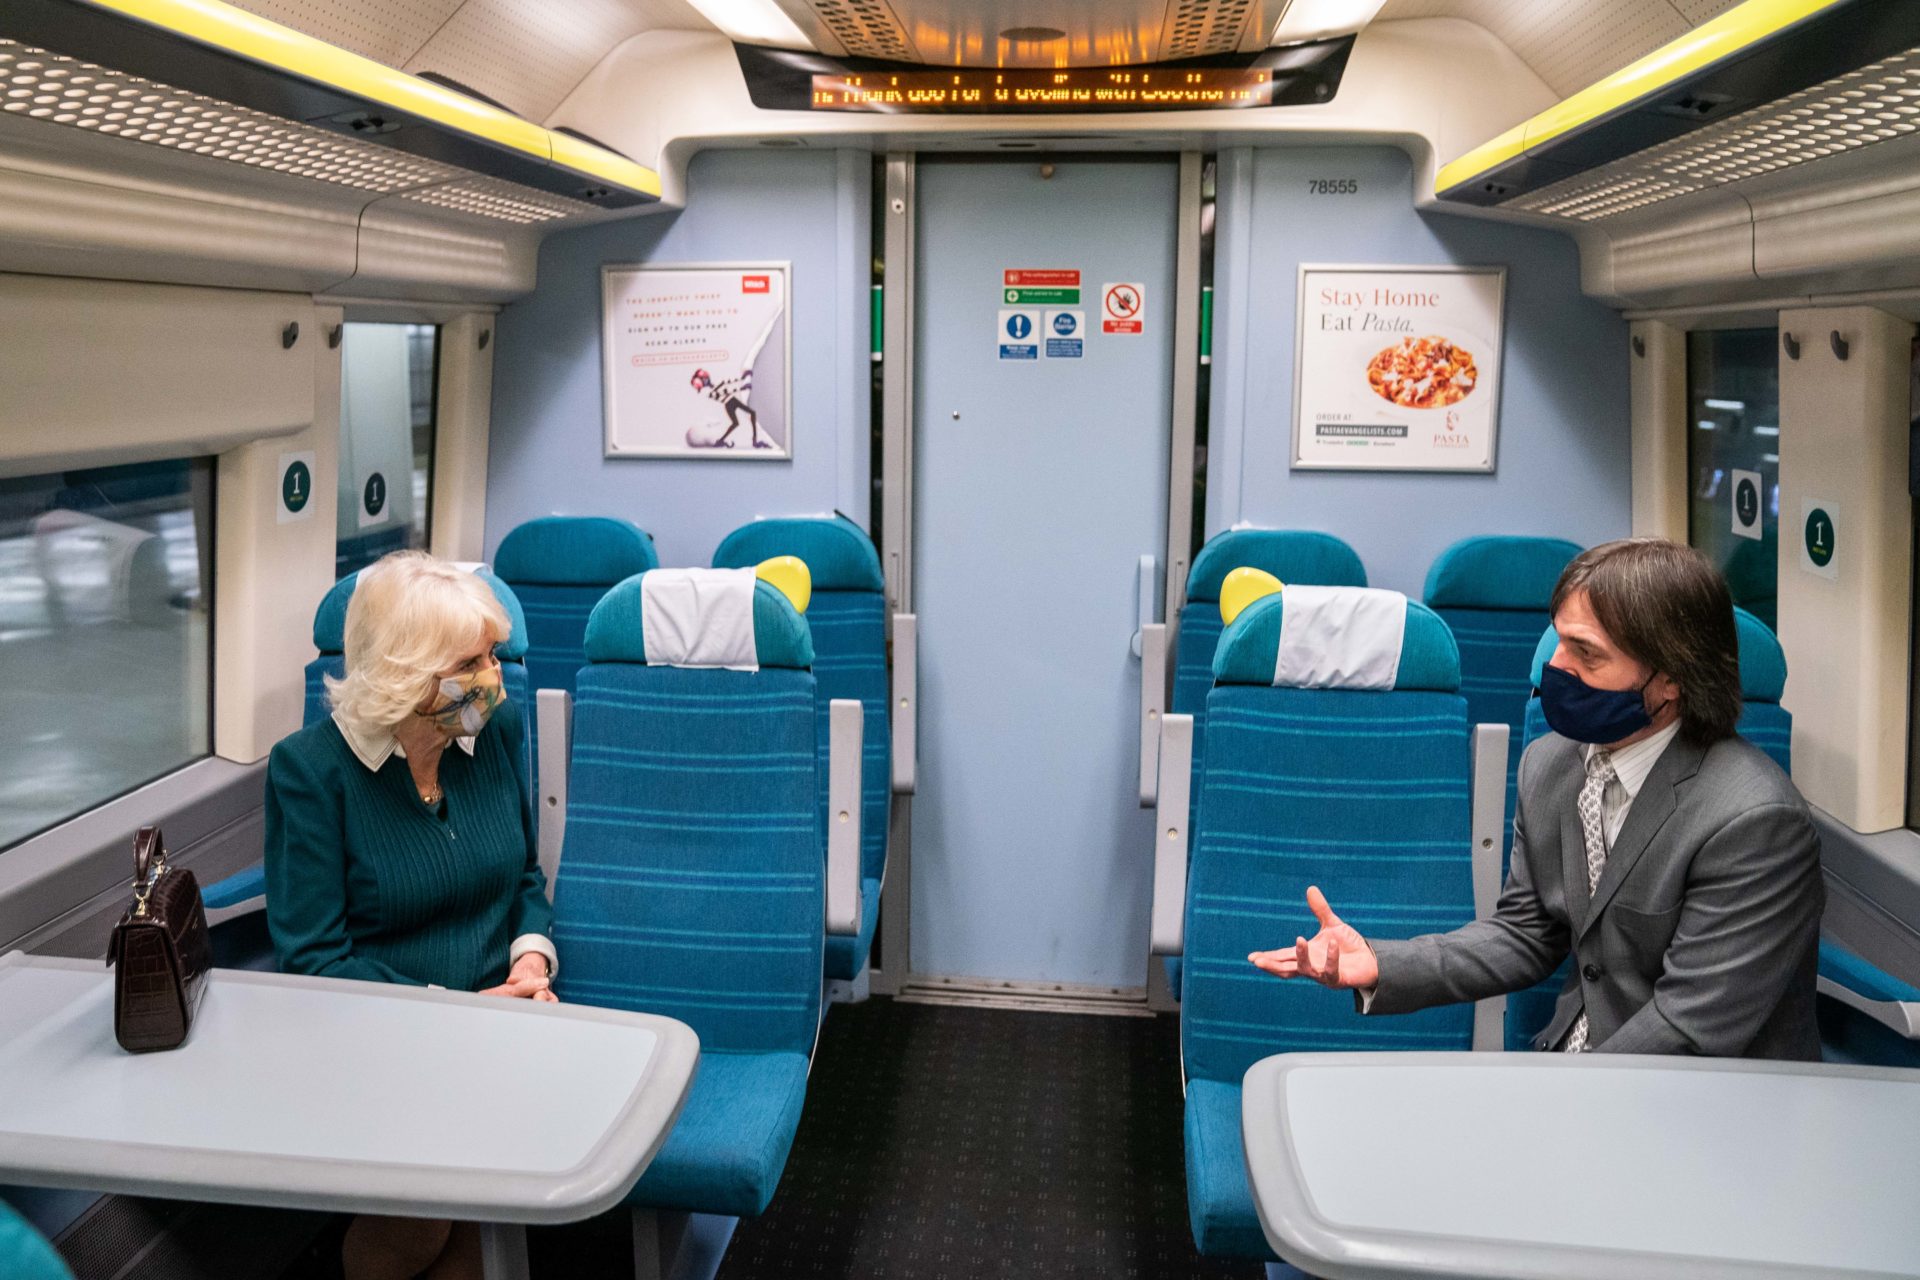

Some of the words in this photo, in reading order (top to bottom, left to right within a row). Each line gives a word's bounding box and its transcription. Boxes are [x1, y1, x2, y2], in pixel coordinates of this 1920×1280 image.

[1309, 179, 1358, 195] 78555
[1320, 288, 1364, 311] Stay
[1374, 289, 1440, 307] Home
[1320, 313, 1352, 331] Eat
[1361, 313, 1415, 332] Pasta.
[1316, 413, 1342, 421] ORDER
[1320, 426, 1403, 436] PASTAEVANGELISTS.COM
[1433, 434, 1470, 444] PASTA
